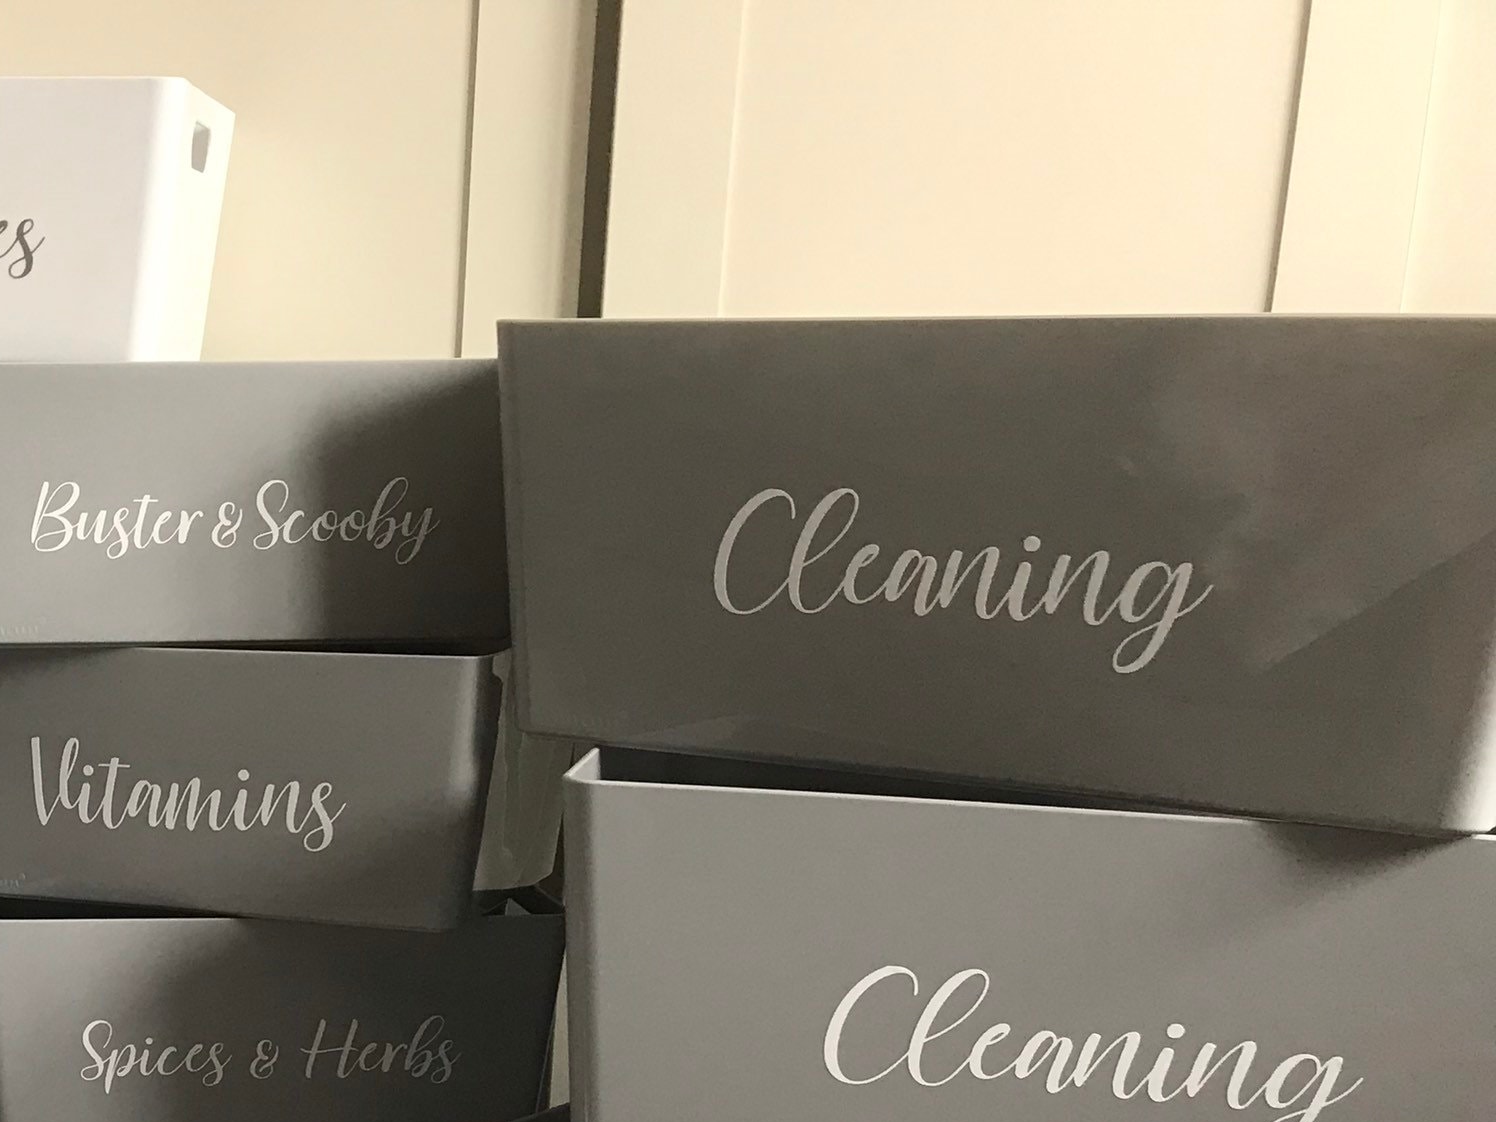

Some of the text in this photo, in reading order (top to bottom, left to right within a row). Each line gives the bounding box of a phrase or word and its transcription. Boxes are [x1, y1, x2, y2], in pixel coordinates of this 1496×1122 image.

[31, 477, 440, 565] Buster & Scooby
[714, 487, 1214, 674] Cleaning
[30, 737, 346, 852] Vitamins
[80, 1015, 461, 1094] Spices & Herbs
